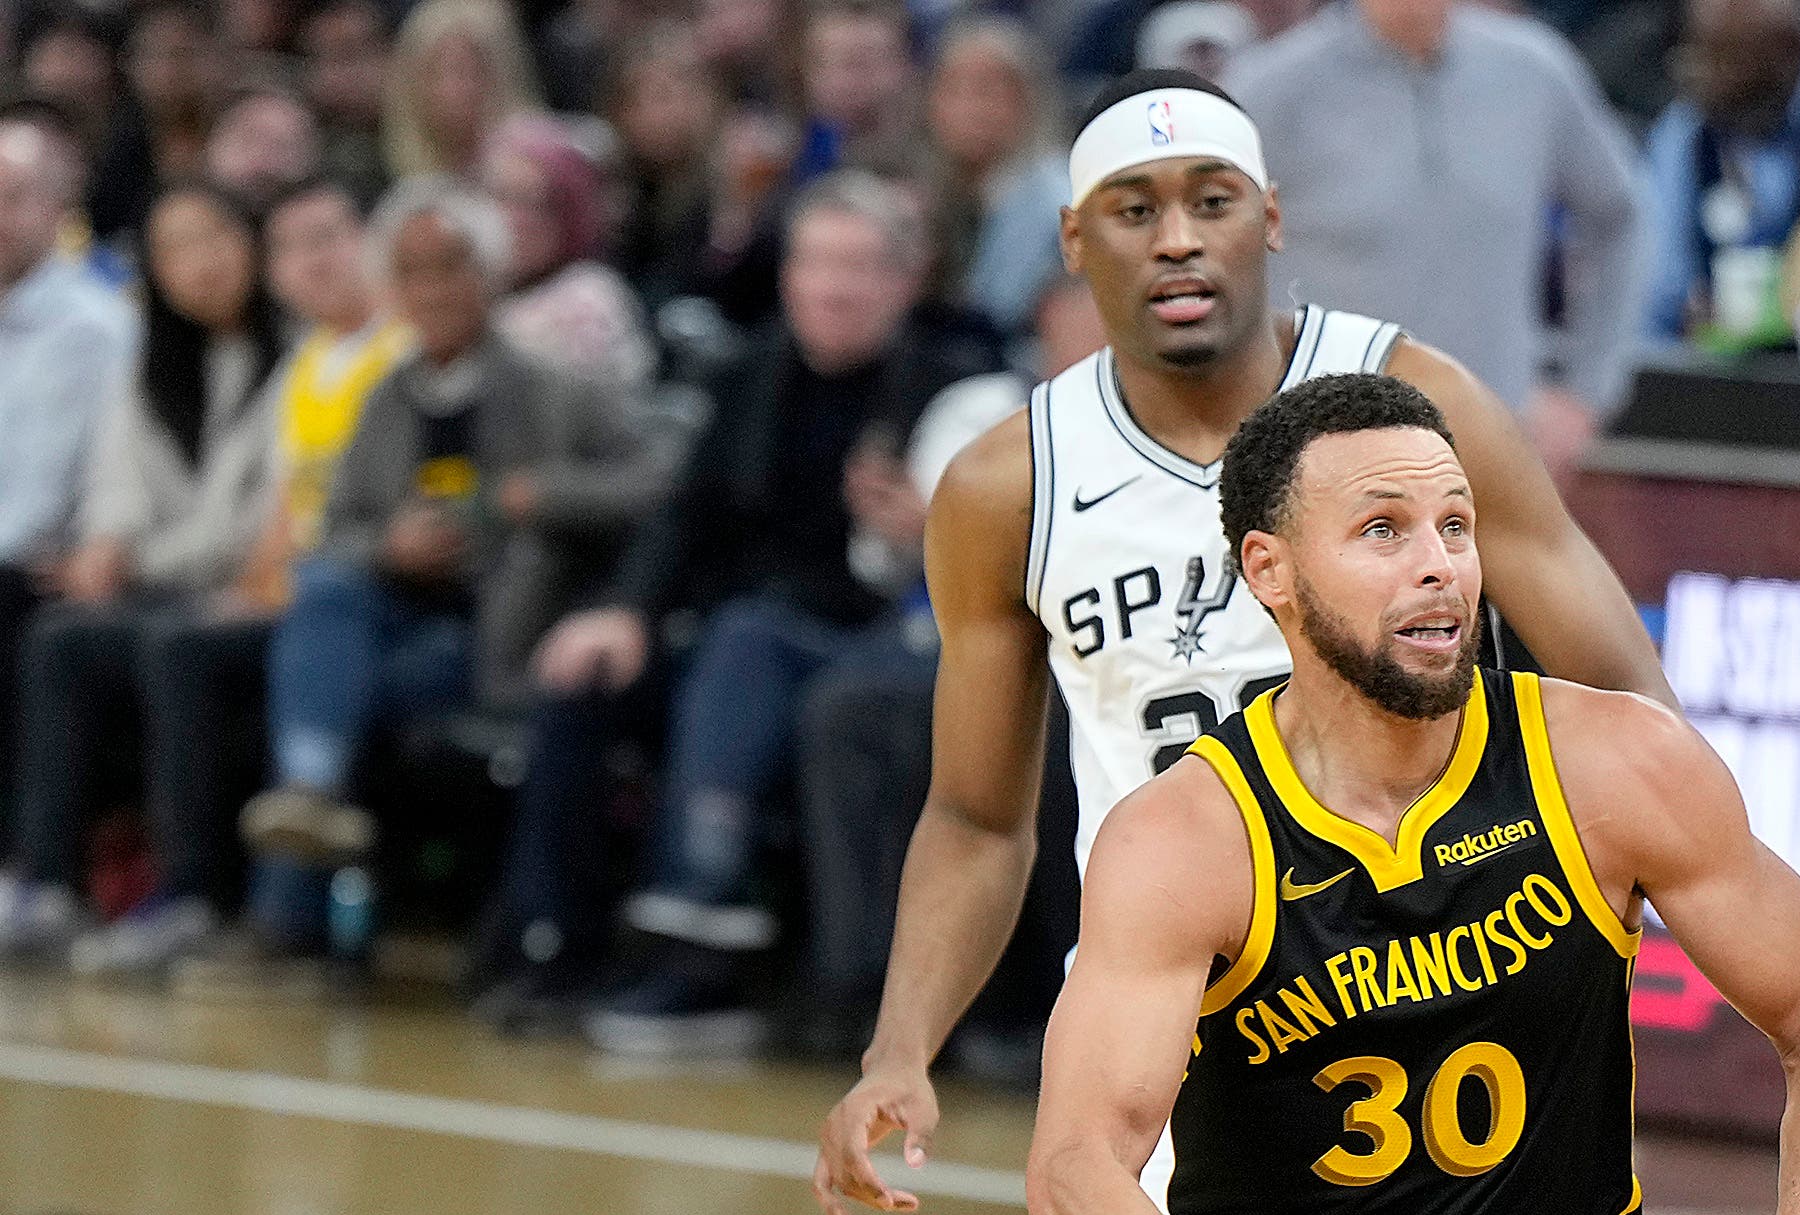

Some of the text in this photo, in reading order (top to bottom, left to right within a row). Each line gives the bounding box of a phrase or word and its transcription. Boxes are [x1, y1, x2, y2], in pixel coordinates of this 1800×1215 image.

[1062, 555, 1239, 667] SPU
[1433, 818, 1537, 867] Rakuten
[1235, 873, 1573, 1065] SAN FRANCISCO
[1310, 1041, 1527, 1187] 30
